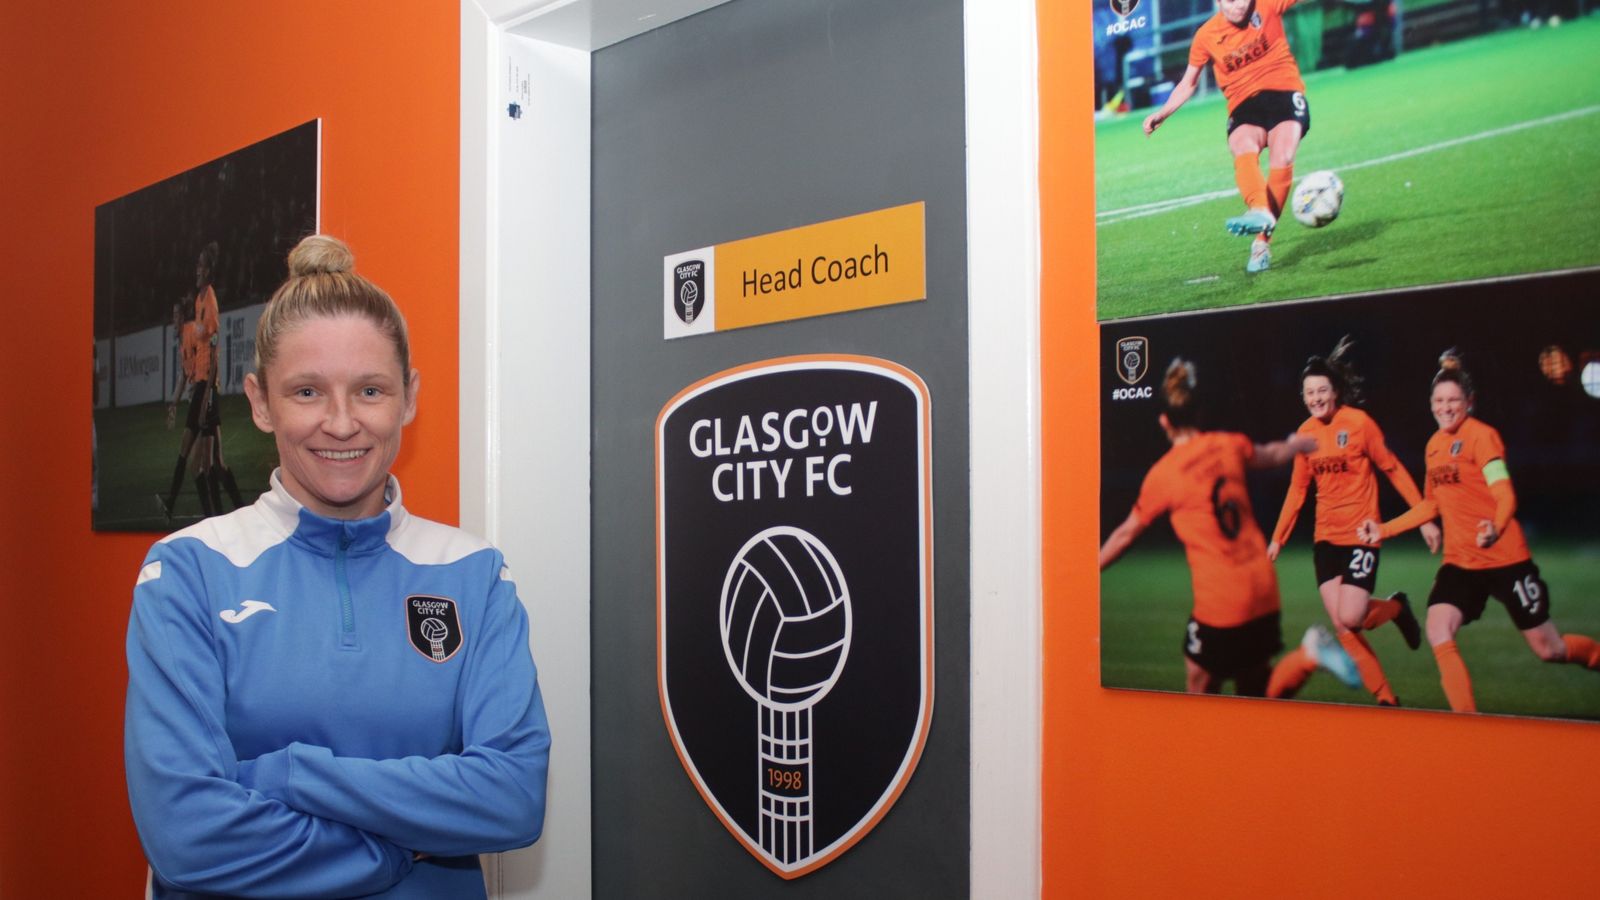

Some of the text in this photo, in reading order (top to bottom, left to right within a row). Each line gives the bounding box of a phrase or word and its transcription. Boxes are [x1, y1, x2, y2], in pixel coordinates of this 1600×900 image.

[1106, 16, 1146, 36] #OCAC
[1226, 40, 1270, 73] SPACE
[1292, 91, 1306, 110] 6
[743, 244, 889, 298] Head Coach
[1112, 386, 1153, 400] #OCAC
[689, 400, 878, 458] GLASGOW
[712, 453, 853, 502] CITY FC
[1211, 475, 1241, 542] 6
[1349, 549, 1374, 574] 20
[1513, 574, 1541, 608] 16
[412, 599, 449, 609] GLASGOW
[417, 607, 446, 616] CITY FC
[767, 767, 802, 790] 1998
